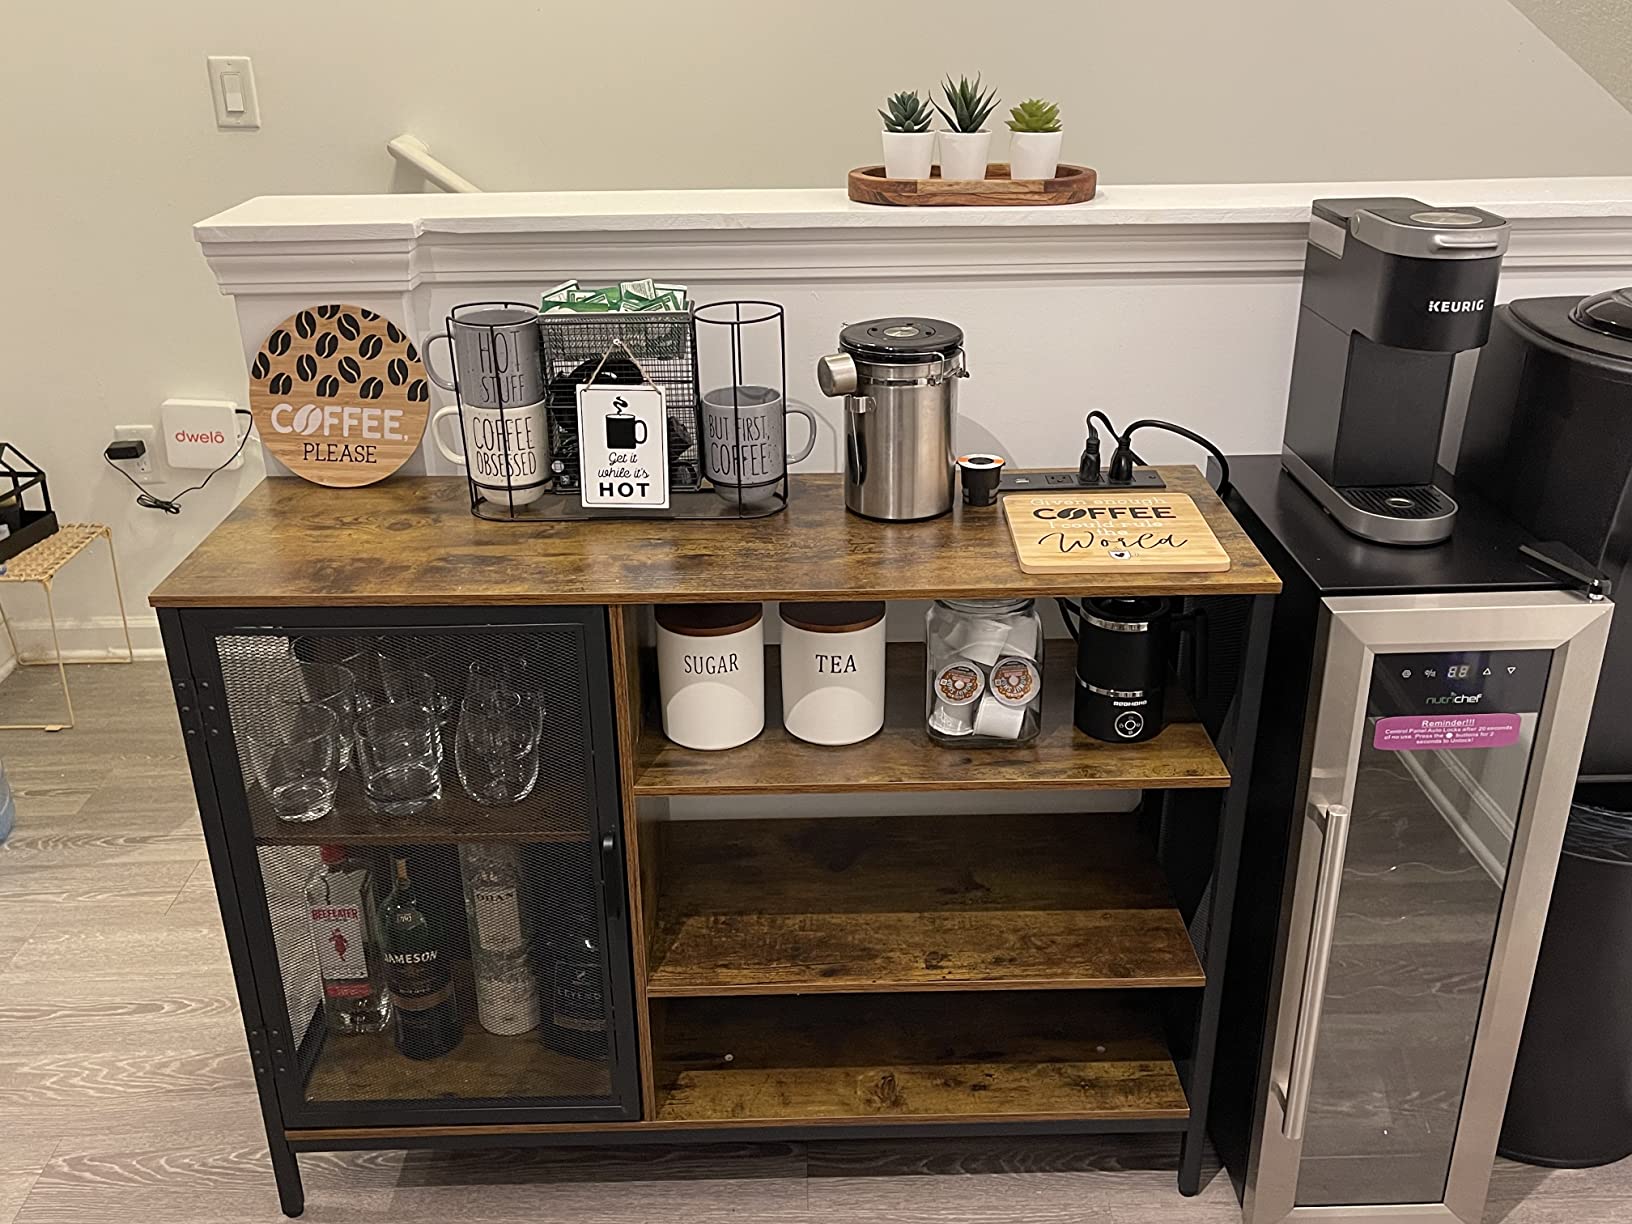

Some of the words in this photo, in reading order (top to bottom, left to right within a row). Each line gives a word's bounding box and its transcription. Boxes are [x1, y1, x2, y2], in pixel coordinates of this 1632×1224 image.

[1428, 299, 1484, 312] KEURIG
[478, 330, 520, 373] HOT
[481, 374, 525, 403] STUFF
[473, 416, 535, 451] COFFEE
[709, 414, 728, 440] BUT
[303, 443, 378, 463] PLEASE
[608, 451, 627, 466] Get
[630, 453, 638, 463] it
[711, 442, 769, 476] COFFEE
[477, 451, 537, 477] OBSESSED
[598, 467, 631, 478] while
[633, 467, 650, 478] it's
[599, 482, 650, 498] HOT
[1030, 498, 1086, 507] Given
[1092, 497, 1168, 507] enough
[1033, 507, 1177, 520] COFFEE
[1050, 520, 1056, 529] I
[1058, 520, 1115, 529] could
[1120, 519, 1163, 529] rule
[1097, 528, 1129, 537] the
[1038, 531, 1188, 553] World
[684, 653, 739, 675] SUGAR
[815, 654, 857, 674] TEA
[1425, 691, 1482, 704] nutrichef
[1421, 718, 1476, 728] Reminder!!!
[310, 907, 359, 921] BEEFEATER
[384, 949, 438, 965] JAMESON
